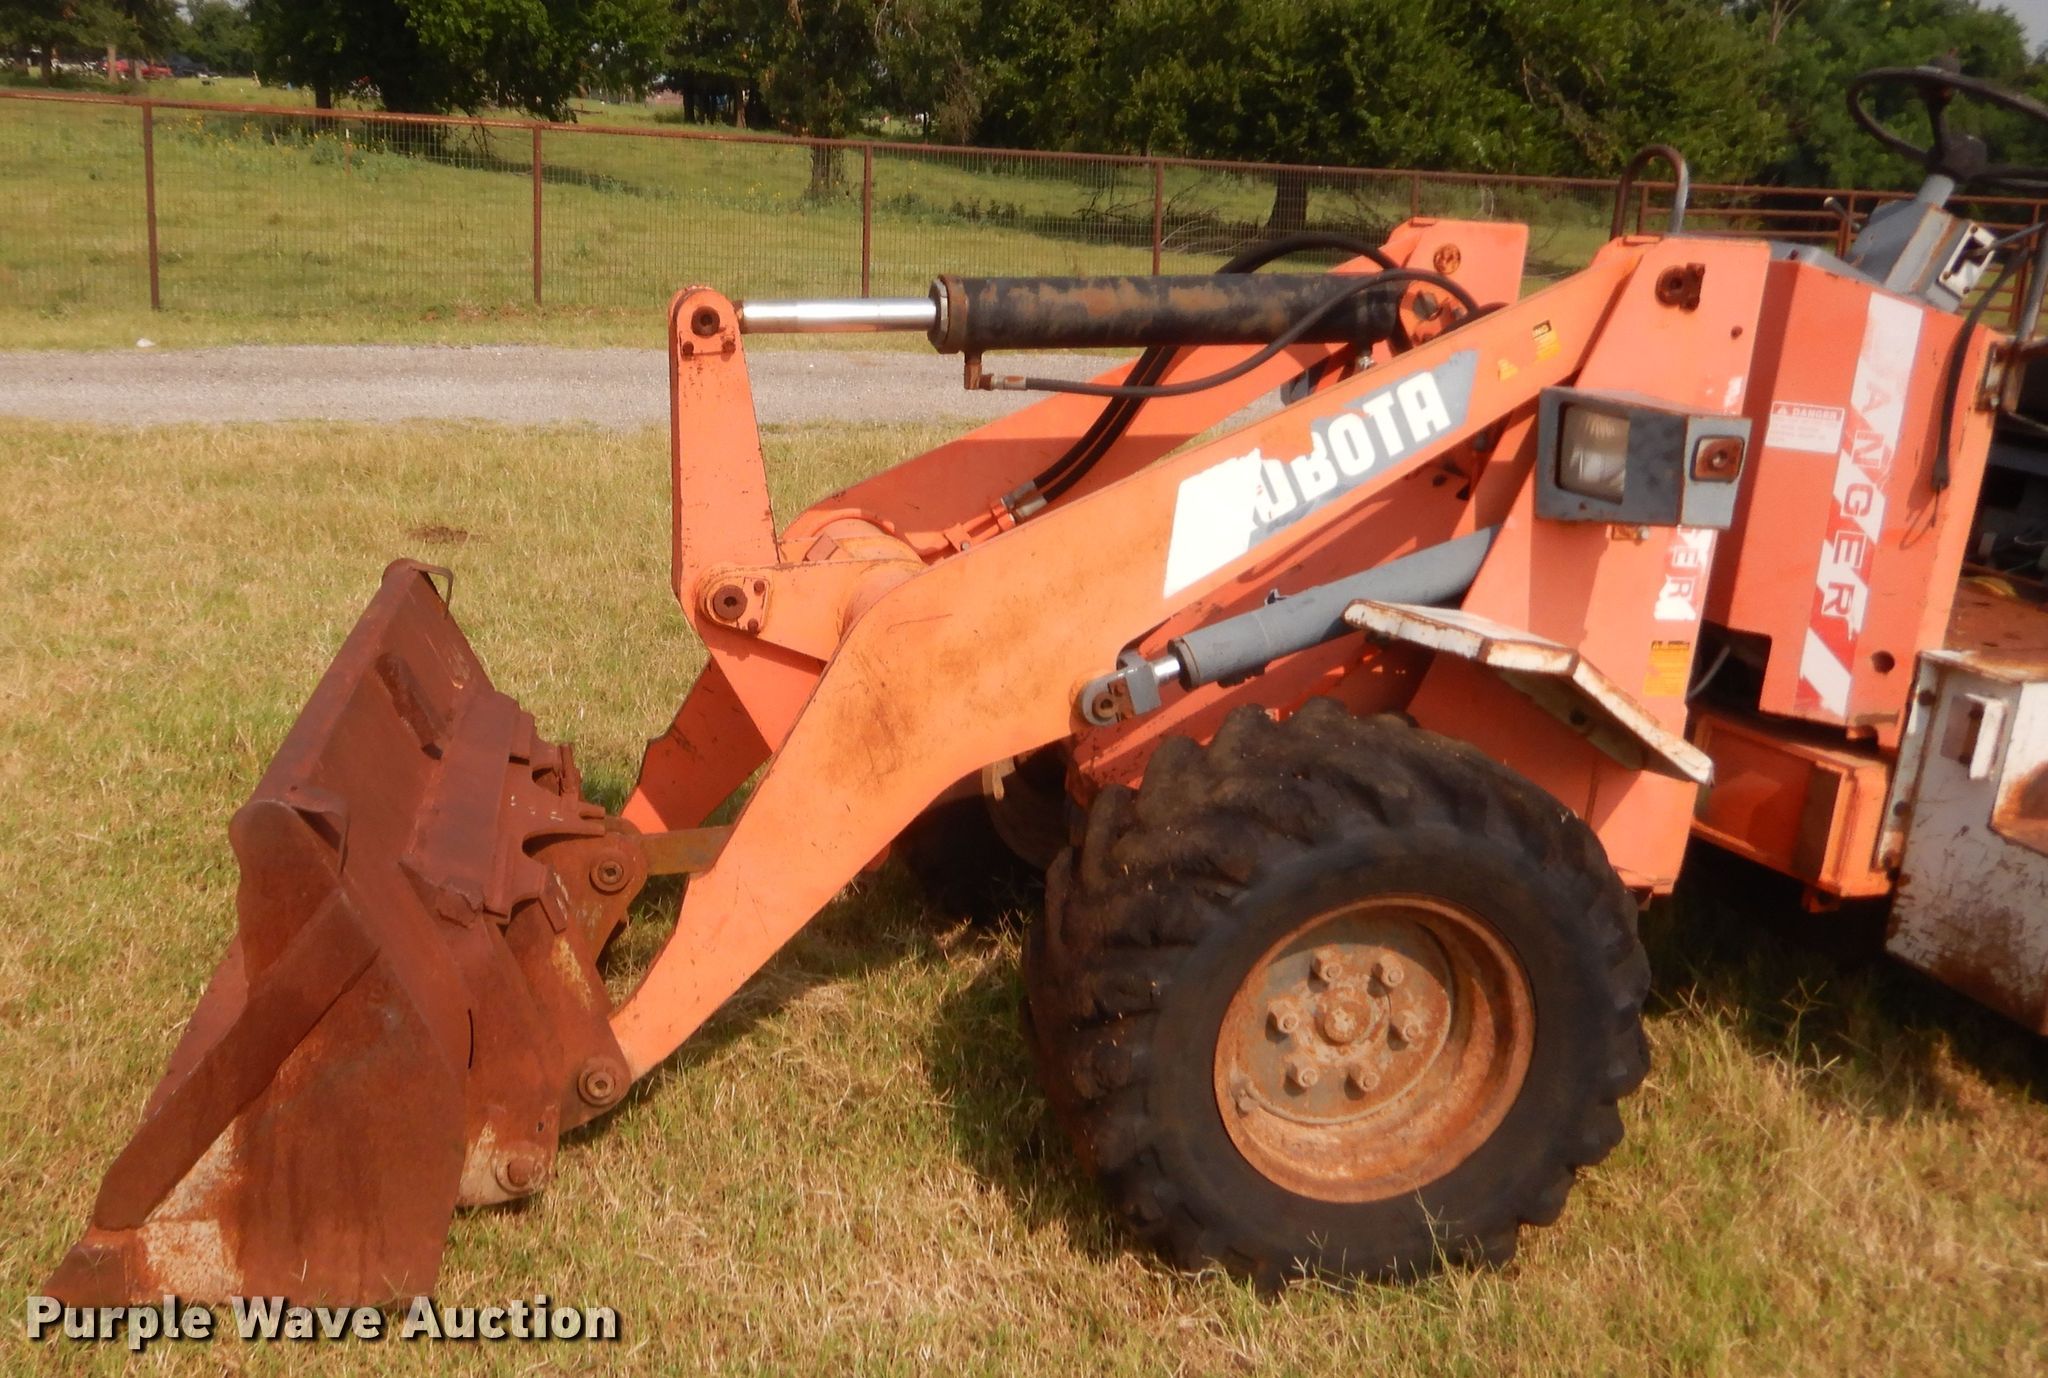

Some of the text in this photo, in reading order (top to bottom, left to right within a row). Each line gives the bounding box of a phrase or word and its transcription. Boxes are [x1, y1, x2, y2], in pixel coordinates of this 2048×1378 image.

[1251, 371, 1452, 523] UBOTA
[1791, 407, 1838, 420] DANGER
[1821, 381, 1892, 616] ANGER
